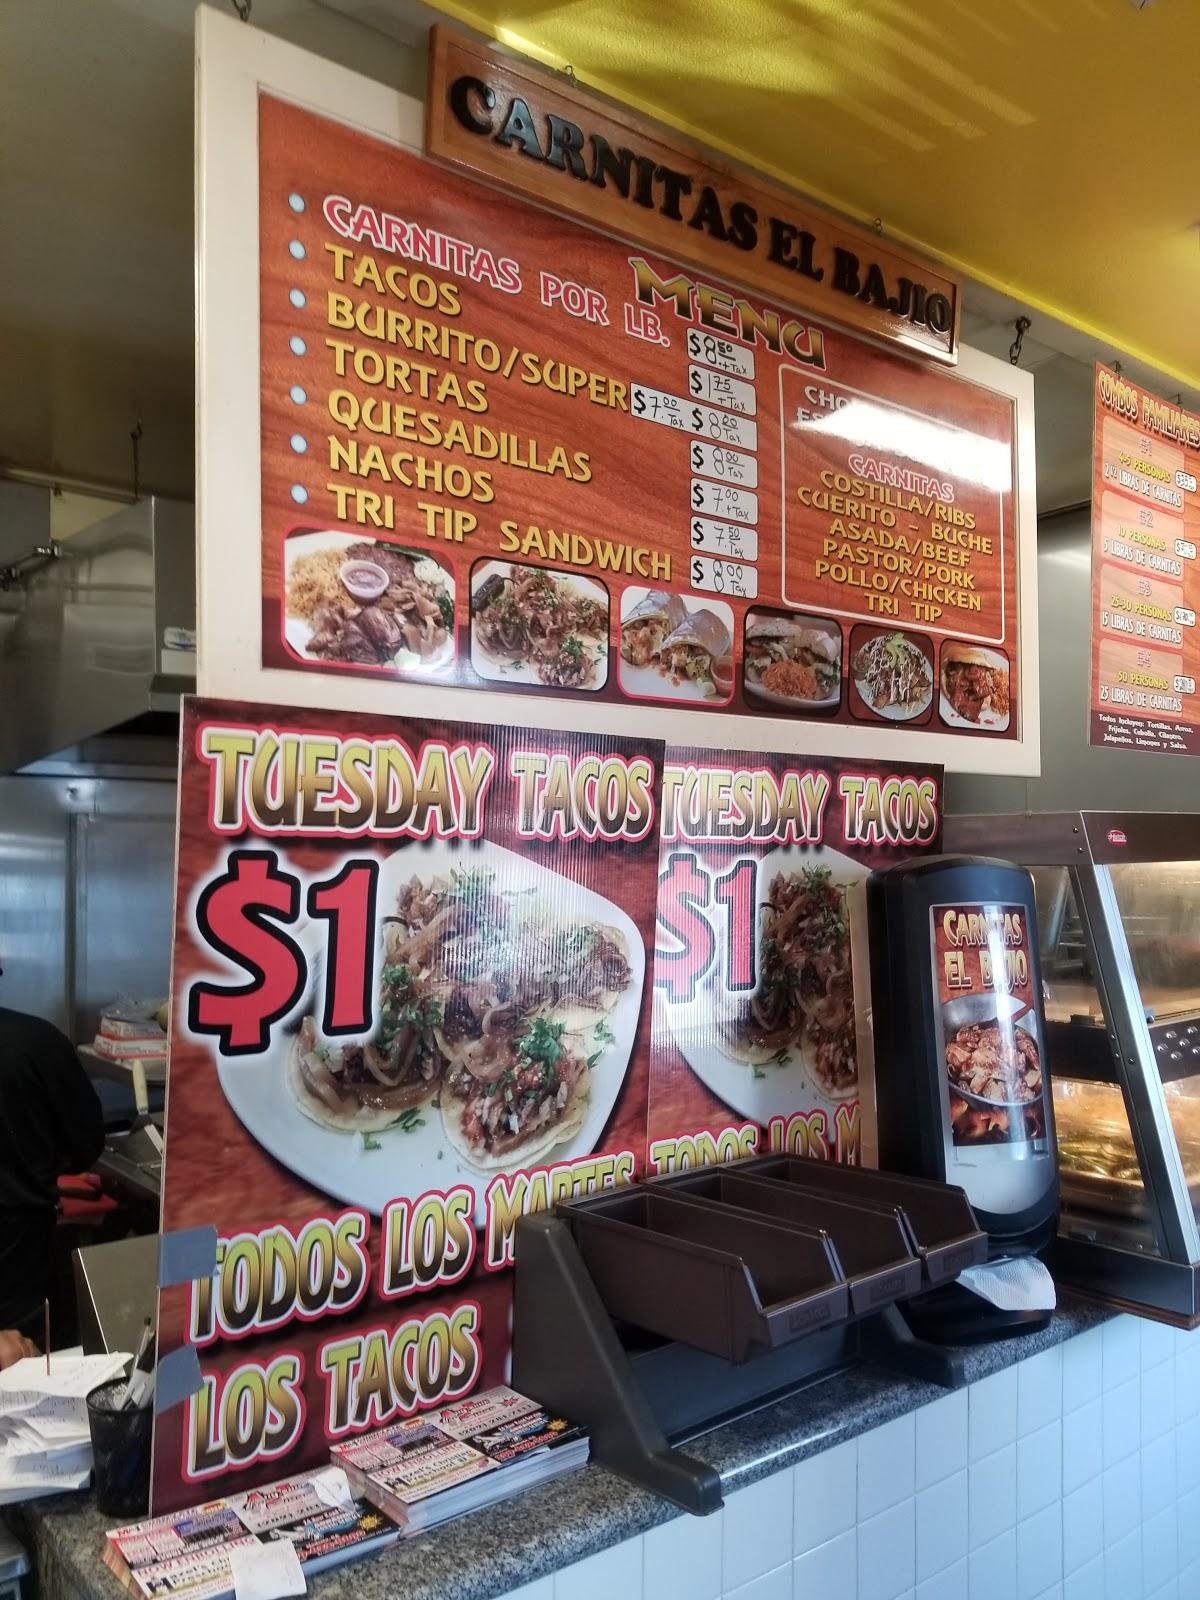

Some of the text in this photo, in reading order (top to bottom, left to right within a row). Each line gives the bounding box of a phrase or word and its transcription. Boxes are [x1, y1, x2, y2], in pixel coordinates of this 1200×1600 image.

[450, 76, 950, 334] CARNITAS EL BAJIO
[323, 195, 670, 347] CARNITAS POR LB.
[325, 242, 461, 316] TACOS
[628, 257, 826, 370] MENU
[325, 339, 489, 413] TORTAS
[327, 291, 629, 411] BURRITO/SUPER
[328, 390, 592, 483] QUESADILLAS
[1099, 370, 1200, 449] COMBOS FAMILIARES
[328, 435, 495, 503] NACHOS
[820, 470, 976, 530] COSTILLA/RIBS
[849, 454, 954, 503] CARNITAS
[1119, 472, 1139, 491] LIBRAS
[1142, 482, 1150, 496] DE
[1152, 485, 1182, 508] CARNITAS
[1133, 457, 1171, 483] PERSONAS
[327, 483, 672, 581] TRI TIP SANDWICH
[797, 486, 896, 527] CUERITO
[931, 522, 993, 555] BUCHE
[829, 518, 970, 567] ASADA/BEEF
[1129, 528, 1166, 551] PERSONAS
[815, 559, 981, 612] POLLO/CHICKEN
[823, 538, 975, 590] PASTOR/PORK
[1111, 540, 1133, 561] LIBRAS
[1136, 548, 1145, 565] DE
[1149, 554, 1181, 576] CARNITAS
[864, 592, 943, 622] TRI TIP
[1111, 613, 1133, 633] LIBRAS
[1136, 623, 1146, 636] DE
[1149, 626, 1181, 644] CARNITAS
[1135, 604, 1172, 622] PERSONAS
[1101, 686, 1182, 712] 25 LIBRAS DE CARNITAS
[1131, 672, 1169, 690] PERSONAS
[201, 727, 654, 837] TUESDAY TACOS
[661, 766, 937, 843] TUESDAY TACOS
[188, 850, 379, 1056] $1
[654, 853, 758, 1004] $1
[944, 910, 1022, 946] CARNTAS
[944, 950, 1028, 992] EL BJIO
[384, 1189, 474, 1296] LOS
[187, 1303, 479, 1477] LOS TACOS
